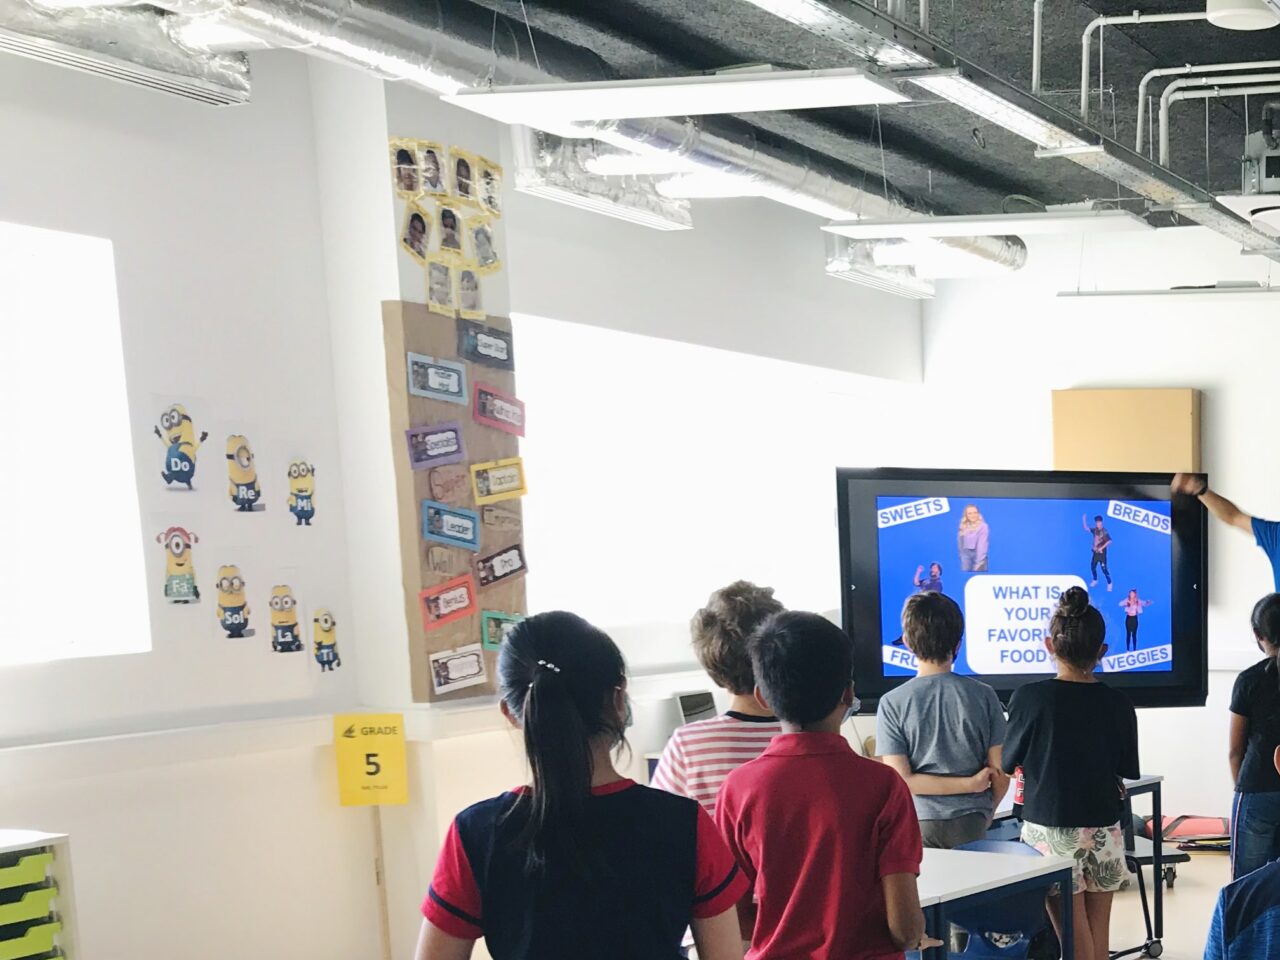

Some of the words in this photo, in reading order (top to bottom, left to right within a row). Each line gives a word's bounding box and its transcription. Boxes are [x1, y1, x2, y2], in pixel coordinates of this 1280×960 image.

[170, 457, 190, 473] Do
[239, 486, 255, 500] Re
[296, 497, 312, 511] Mi
[880, 499, 943, 525] SWEETS
[1112, 503, 1170, 531] BREADS
[172, 579, 188, 593] Fa
[992, 585, 1041, 600] WHAT
[1046, 585, 1061, 600] IS
[224, 611, 245, 625] Sol
[1004, 607, 1051, 621] YOUR
[277, 629, 293, 643] La
[988, 627, 1047, 642] FAVORI
[321, 648, 333, 662] Ti
[890, 650, 918, 668] FRU
[1000, 649, 1047, 663] FOOD
[1107, 647, 1169, 671] VEGGIES
[360, 726, 398, 736] GRADE
[365, 753, 381, 776] 5
